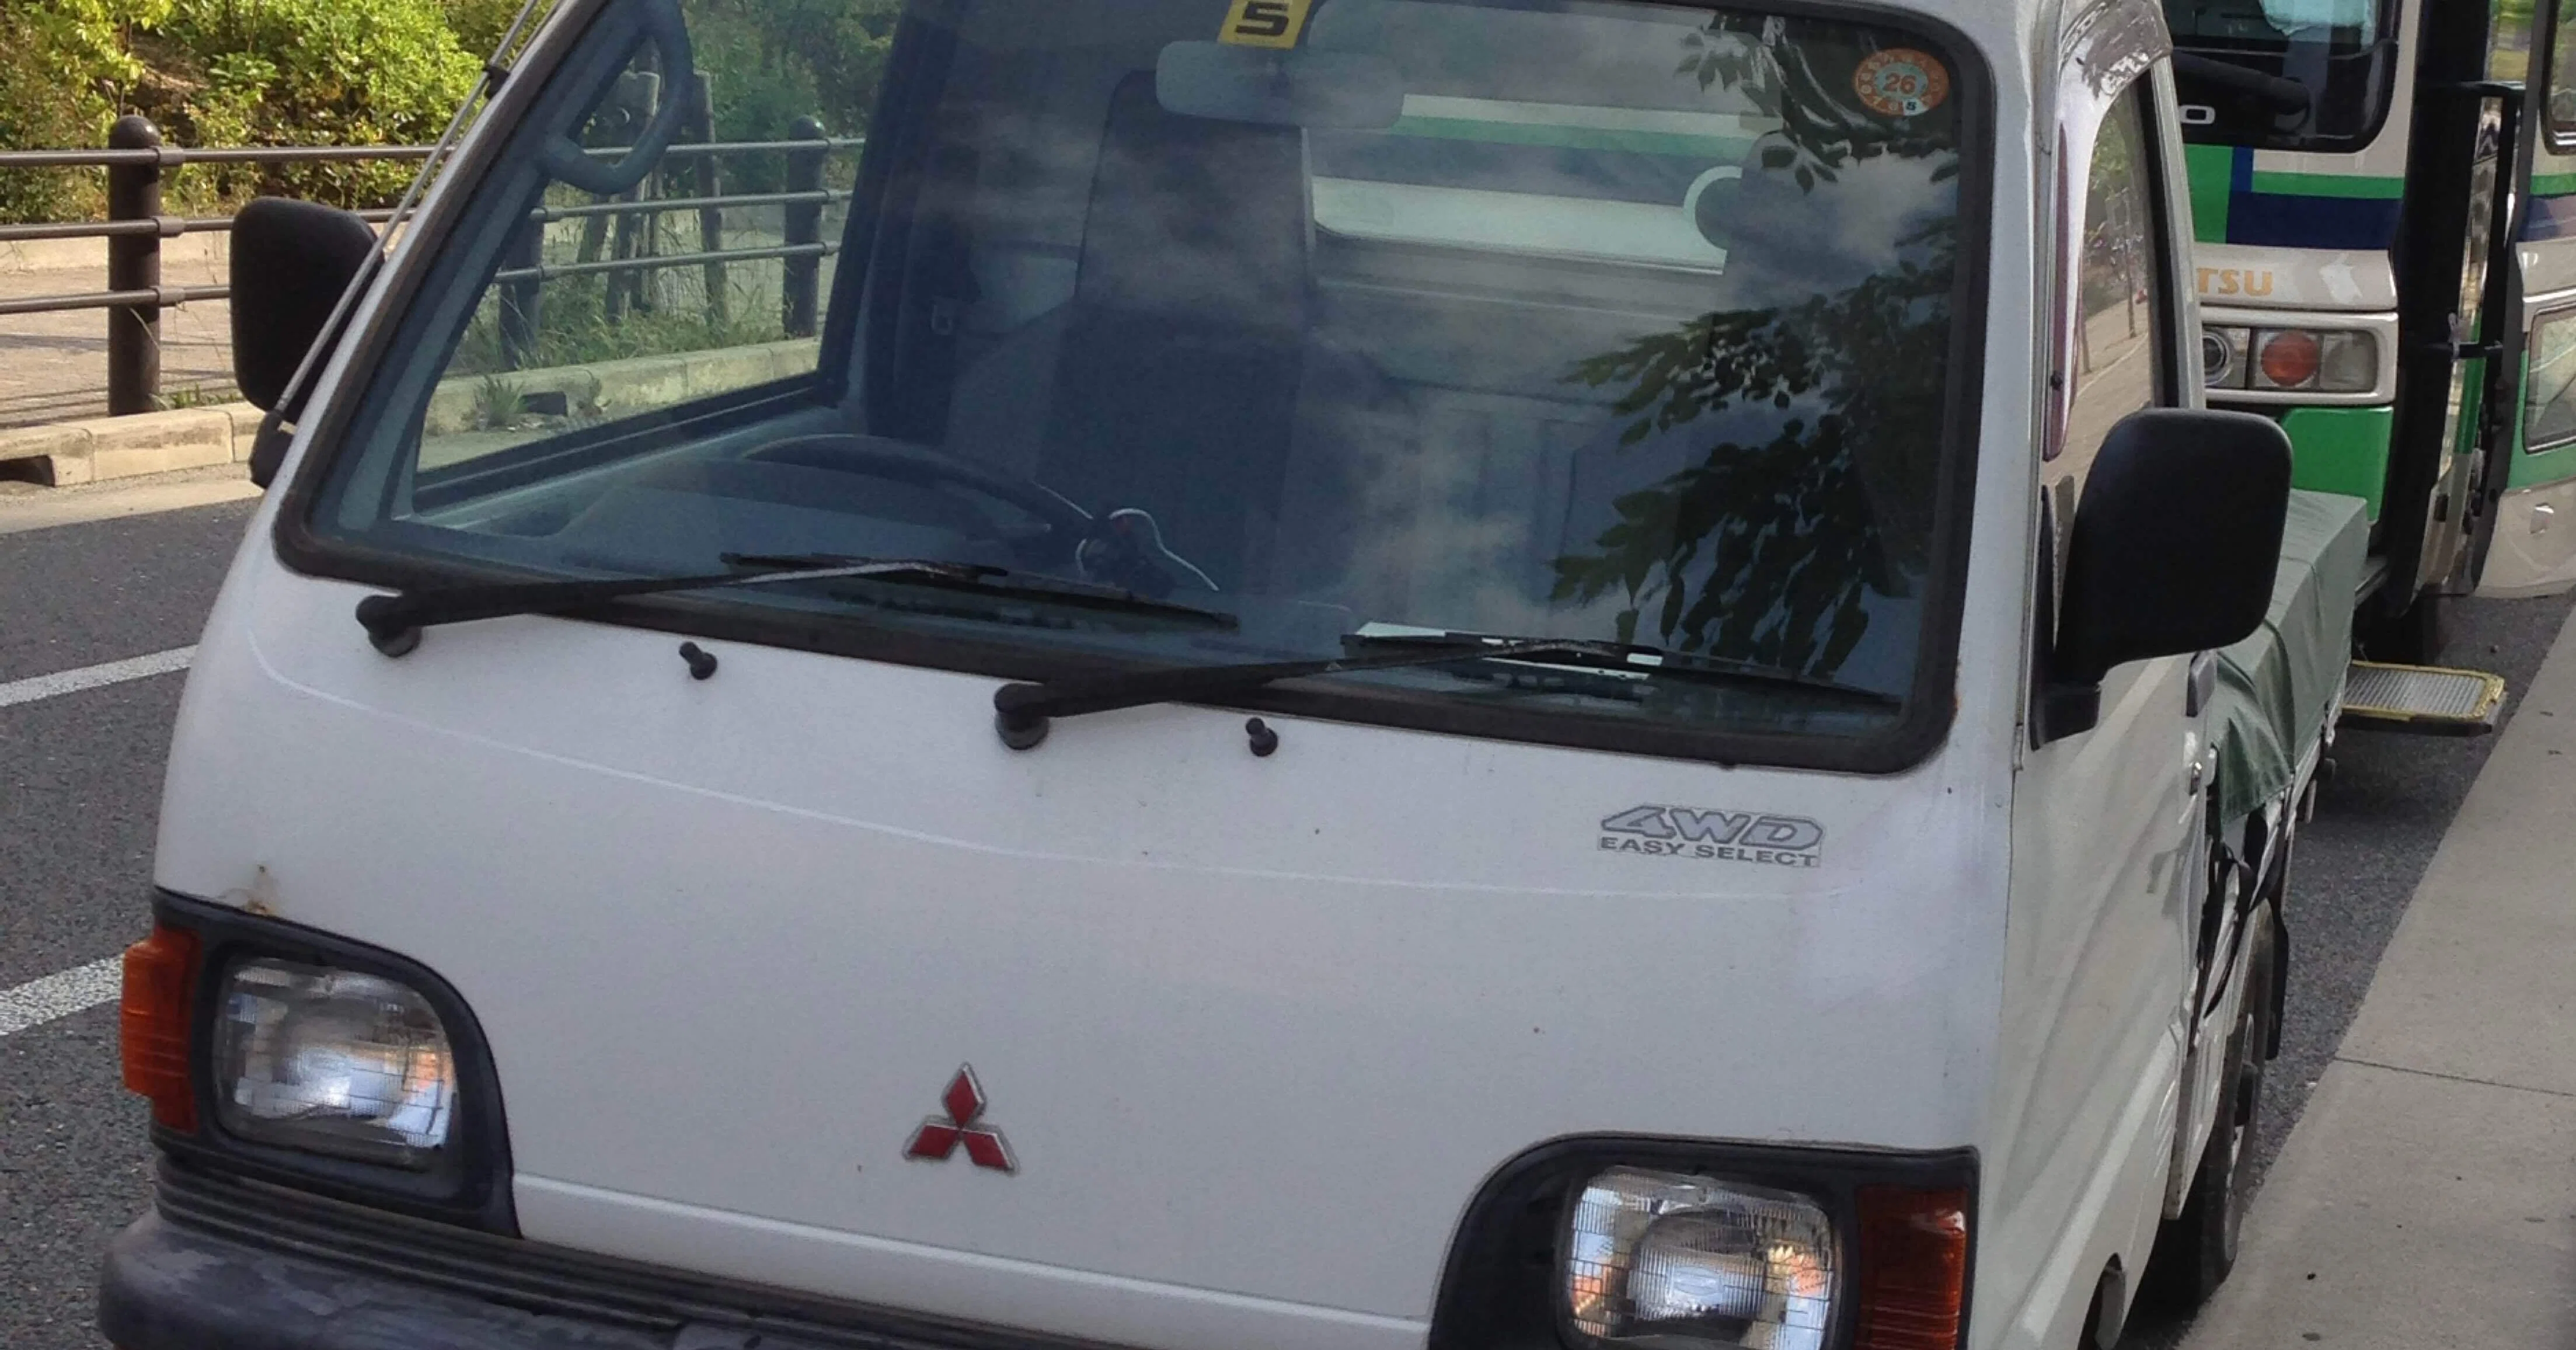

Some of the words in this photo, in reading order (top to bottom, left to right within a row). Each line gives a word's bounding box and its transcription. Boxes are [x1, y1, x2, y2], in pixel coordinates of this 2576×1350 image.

[1883, 72, 1918, 95] 26
[2196, 267, 2273, 297] TSU
[1601, 805, 1823, 850] 4WD
[1601, 837, 1685, 855] EASY
[1696, 844, 1818, 867] SELECT
